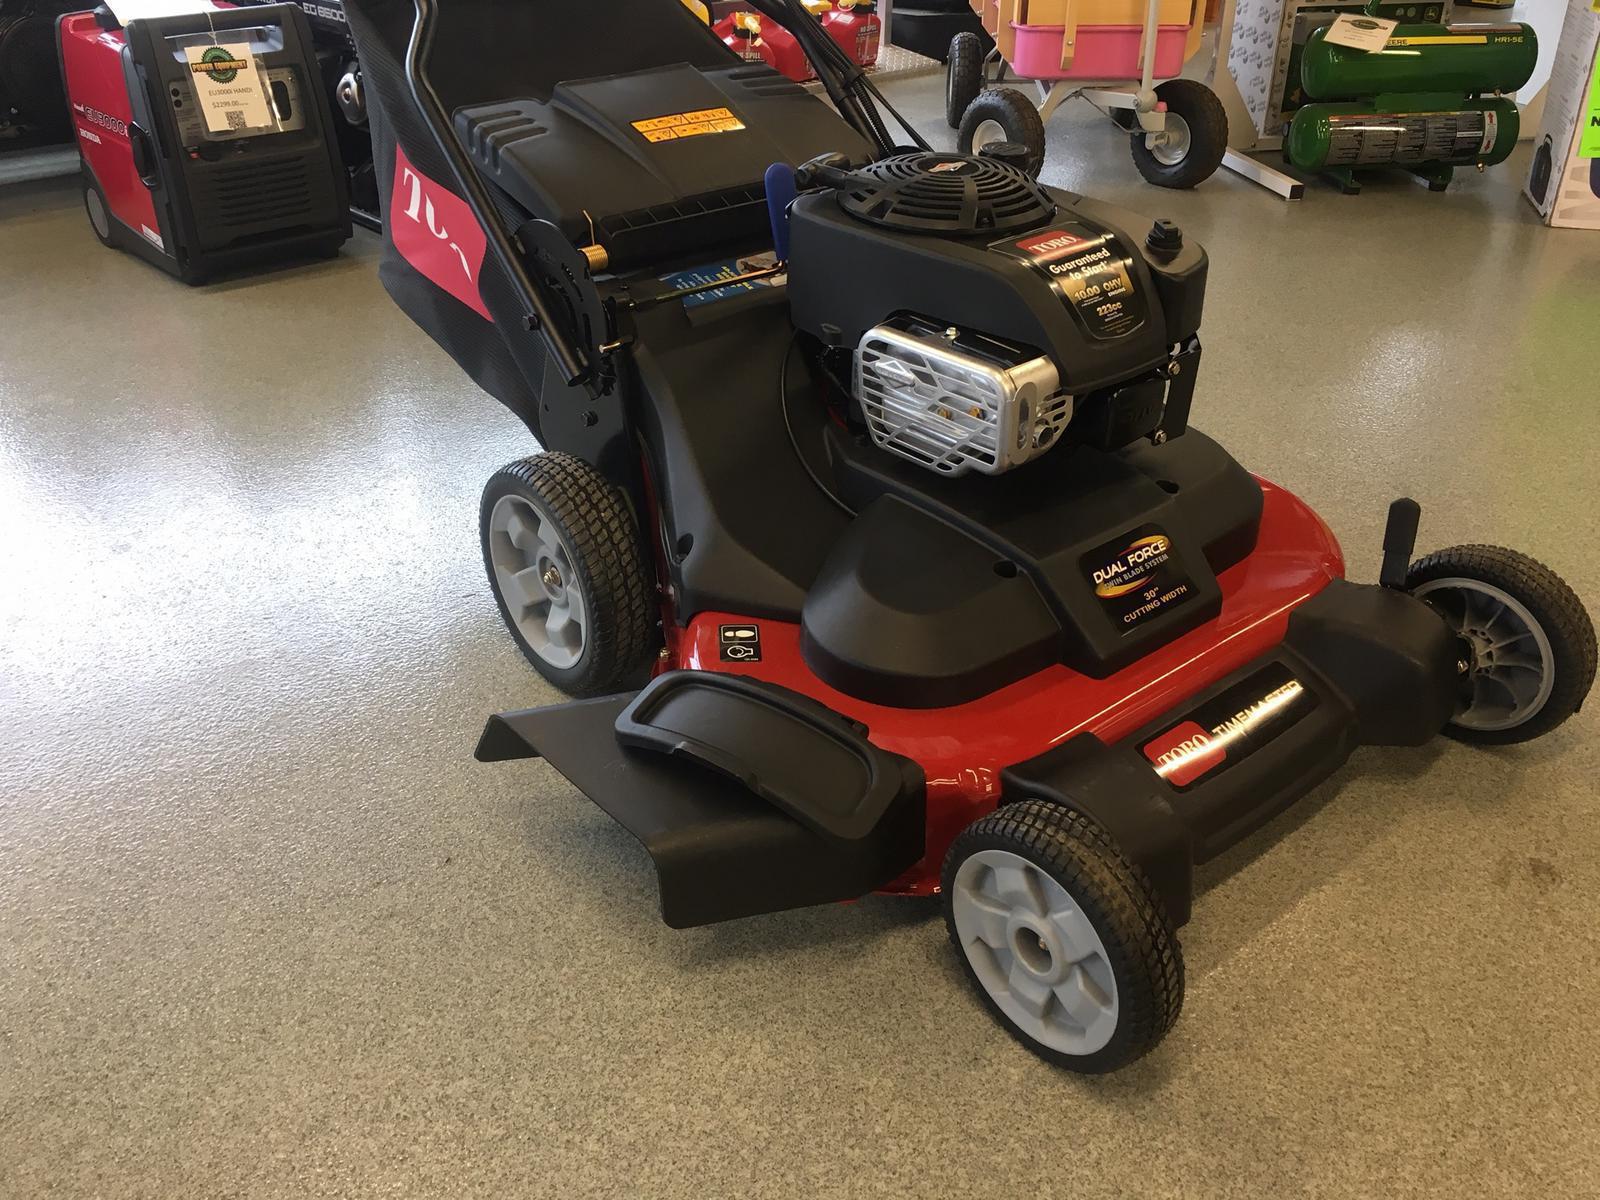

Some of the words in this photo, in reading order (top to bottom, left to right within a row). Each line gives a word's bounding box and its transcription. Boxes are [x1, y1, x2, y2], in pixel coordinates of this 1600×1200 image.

[213, 59, 247, 71] EQUIPMENT
[1028, 235, 1078, 253] TORO
[1049, 247, 1111, 274] Guaranteed
[1069, 270, 1082, 281] to
[1074, 285, 1101, 301] 10.00
[1103, 277, 1122, 292] OHV
[1096, 301, 1123, 316] 223cc
[1093, 560, 1127, 584] DUAL
[1127, 539, 1167, 567] FORCE
[1123, 566, 1145, 581] BLADE
[1145, 553, 1169, 570] SYSTEM
[1123, 599, 1161, 623] CUTTING
[1160, 584, 1188, 603] WIDTH
[1157, 733, 1210, 770] TORO
